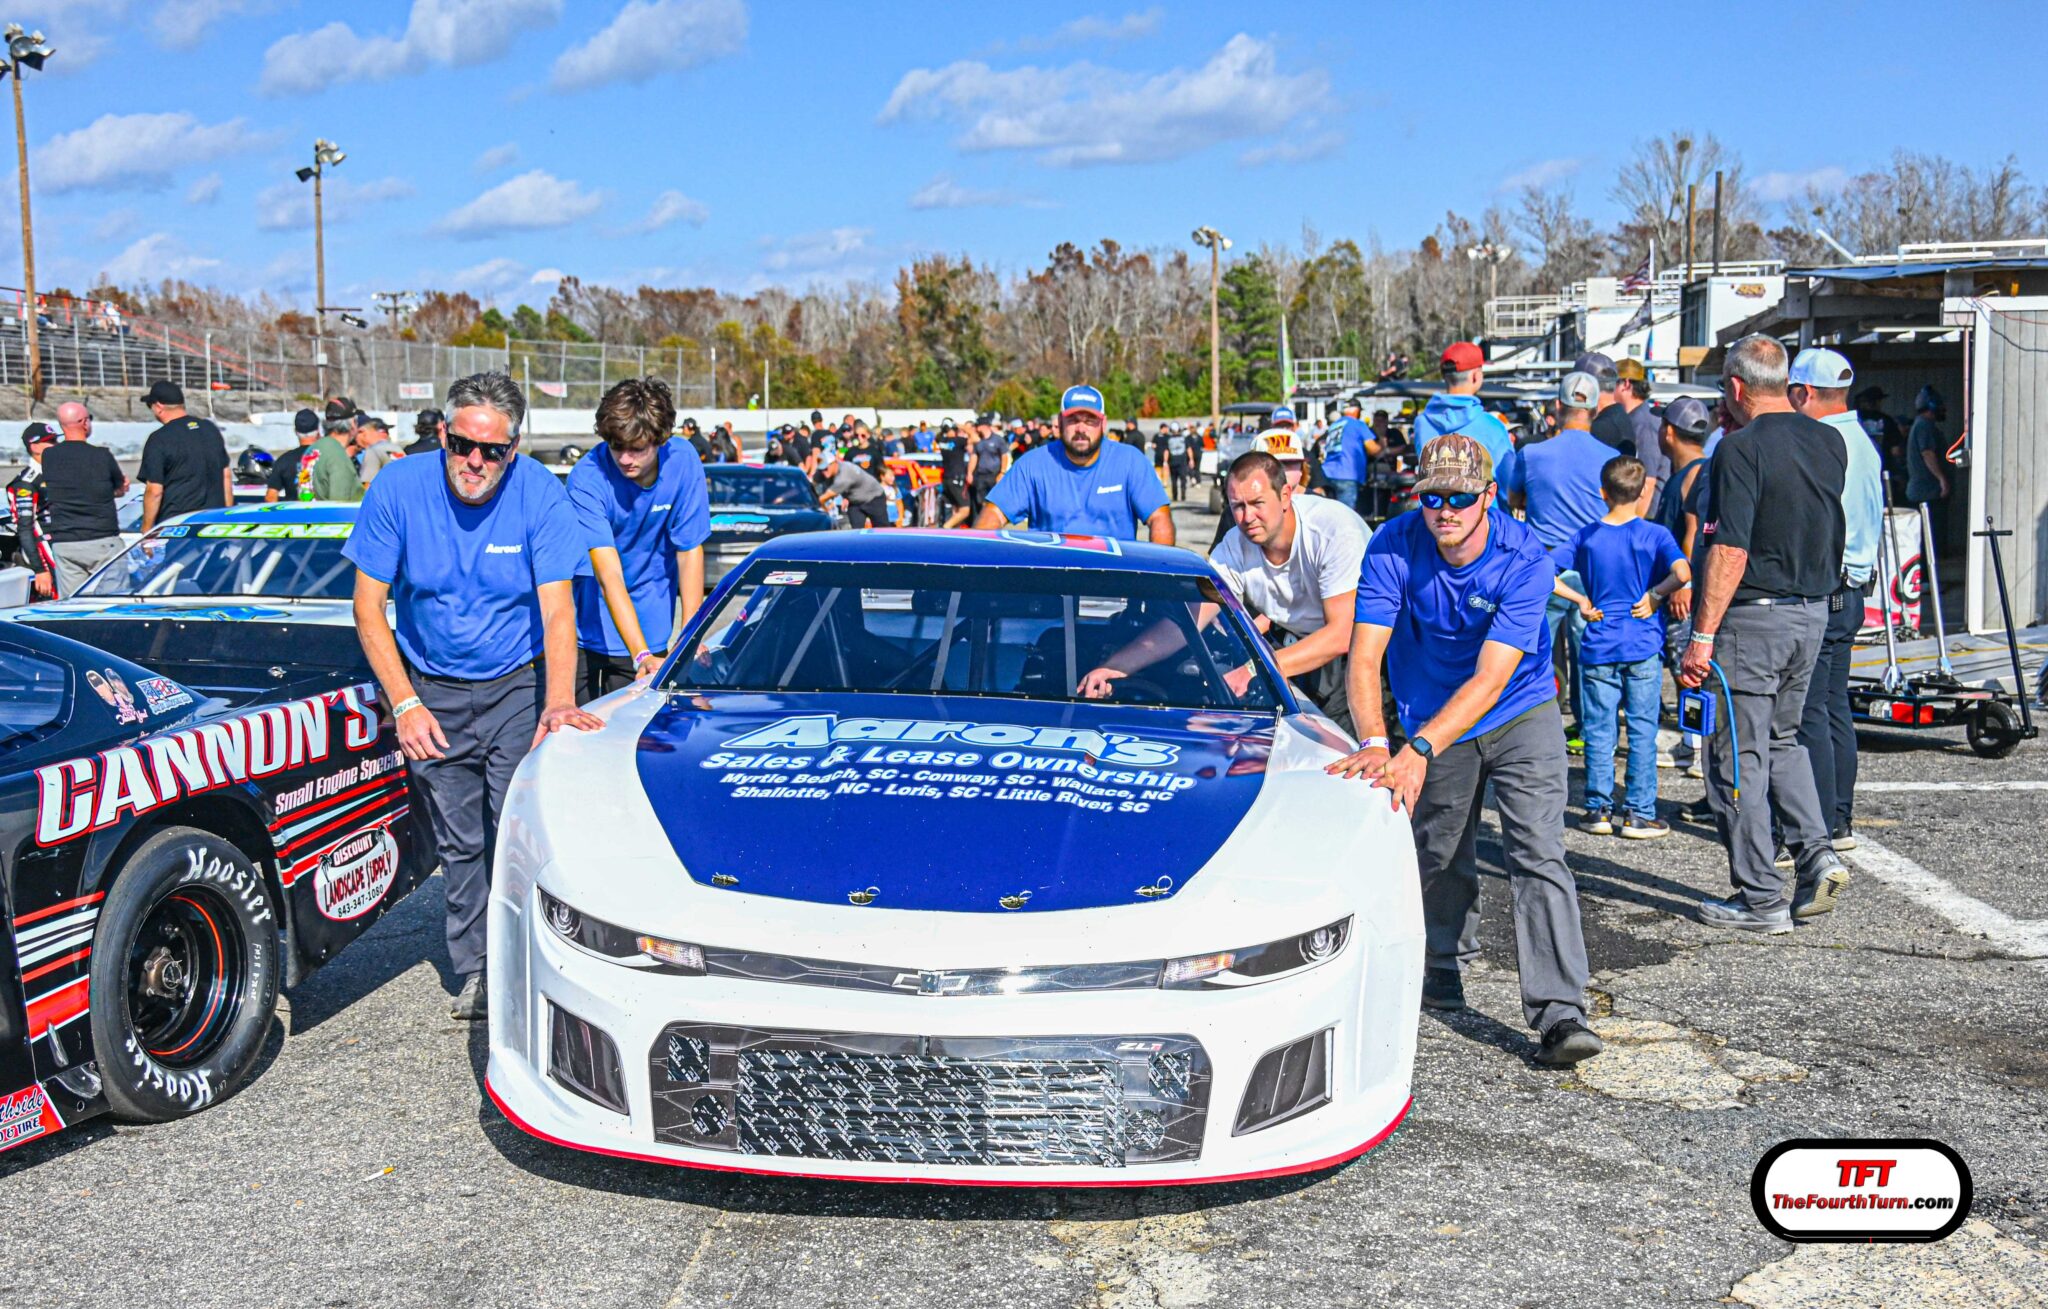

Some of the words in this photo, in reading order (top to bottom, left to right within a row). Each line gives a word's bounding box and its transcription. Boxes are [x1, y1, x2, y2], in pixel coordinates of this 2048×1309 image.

[159, 526, 190, 537] 28
[720, 714, 1182, 767] Aaron's
[34, 683, 379, 848] CANNON'S
[700, 752, 815, 770] Sales
[817, 745, 852, 770] &
[857, 745, 982, 768] Lease
[989, 751, 1198, 791] Ownership
[719, 773, 789, 785] Myrtle
[791, 768, 860, 785] Beach,
[866, 768, 899, 780] SC
[912, 769, 999, 786] Conway,
[1003, 773, 1036, 786] SC
[1052, 776, 1136, 800] Wallace,
[1141, 790, 1176, 801] NC
[275, 781, 314, 815] Small
[316, 767, 358, 798] Engine
[730, 786, 832, 800] Shallotte,
[834, 782, 871, 795] NC
[883, 783, 943, 799] Loris,
[948, 786, 981, 798] SC
[994, 787, 1053, 801] Little
[1055, 790, 1114, 813] River,
[1118, 801, 1151, 813] SC
[333, 833, 373, 866] DISCOUNT
[180, 848, 271, 924] Hoosier
[324, 865, 365, 913] LANDSCAPE
[366, 849, 392, 890] SUPPLY
[337, 884, 384, 918] 843-347-1080
[126, 1031, 213, 1111] Hoosier
[17, 1117, 39, 1134] TIRE
